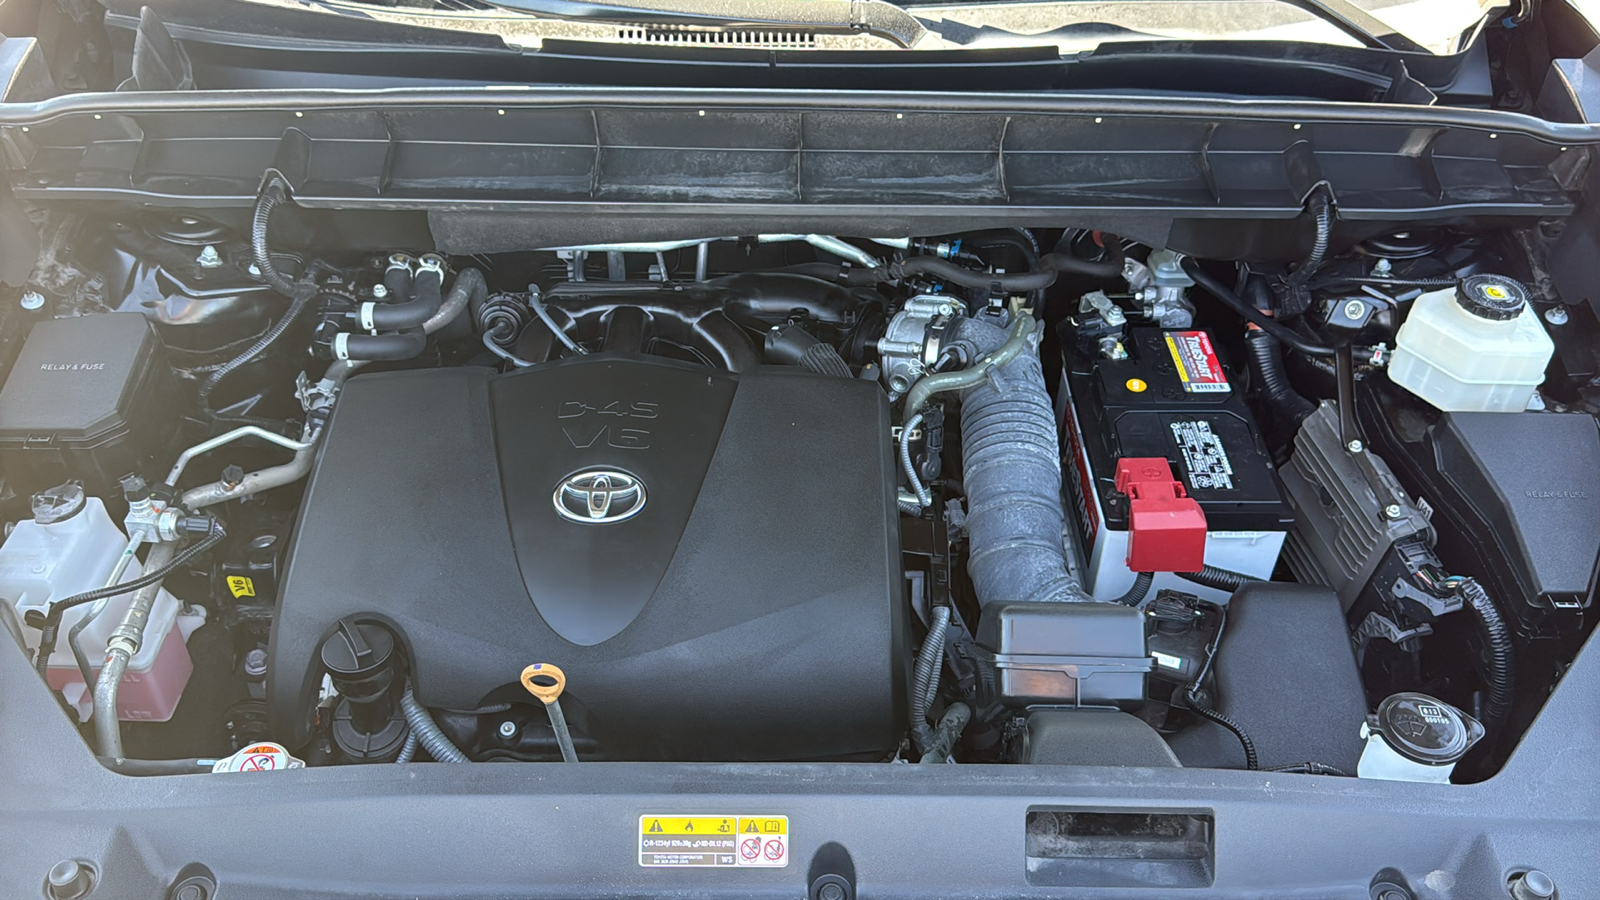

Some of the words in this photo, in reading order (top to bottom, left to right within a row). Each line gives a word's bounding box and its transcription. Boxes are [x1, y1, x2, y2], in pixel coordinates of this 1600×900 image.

[40, 363, 71, 371] RELAY
[558, 400, 659, 419] D-4S
[561, 424, 651, 450] V6
[1525, 490, 1554, 499] RELAY
[1563, 491, 1588, 500] FUSE
[232, 579, 245, 592] V6
